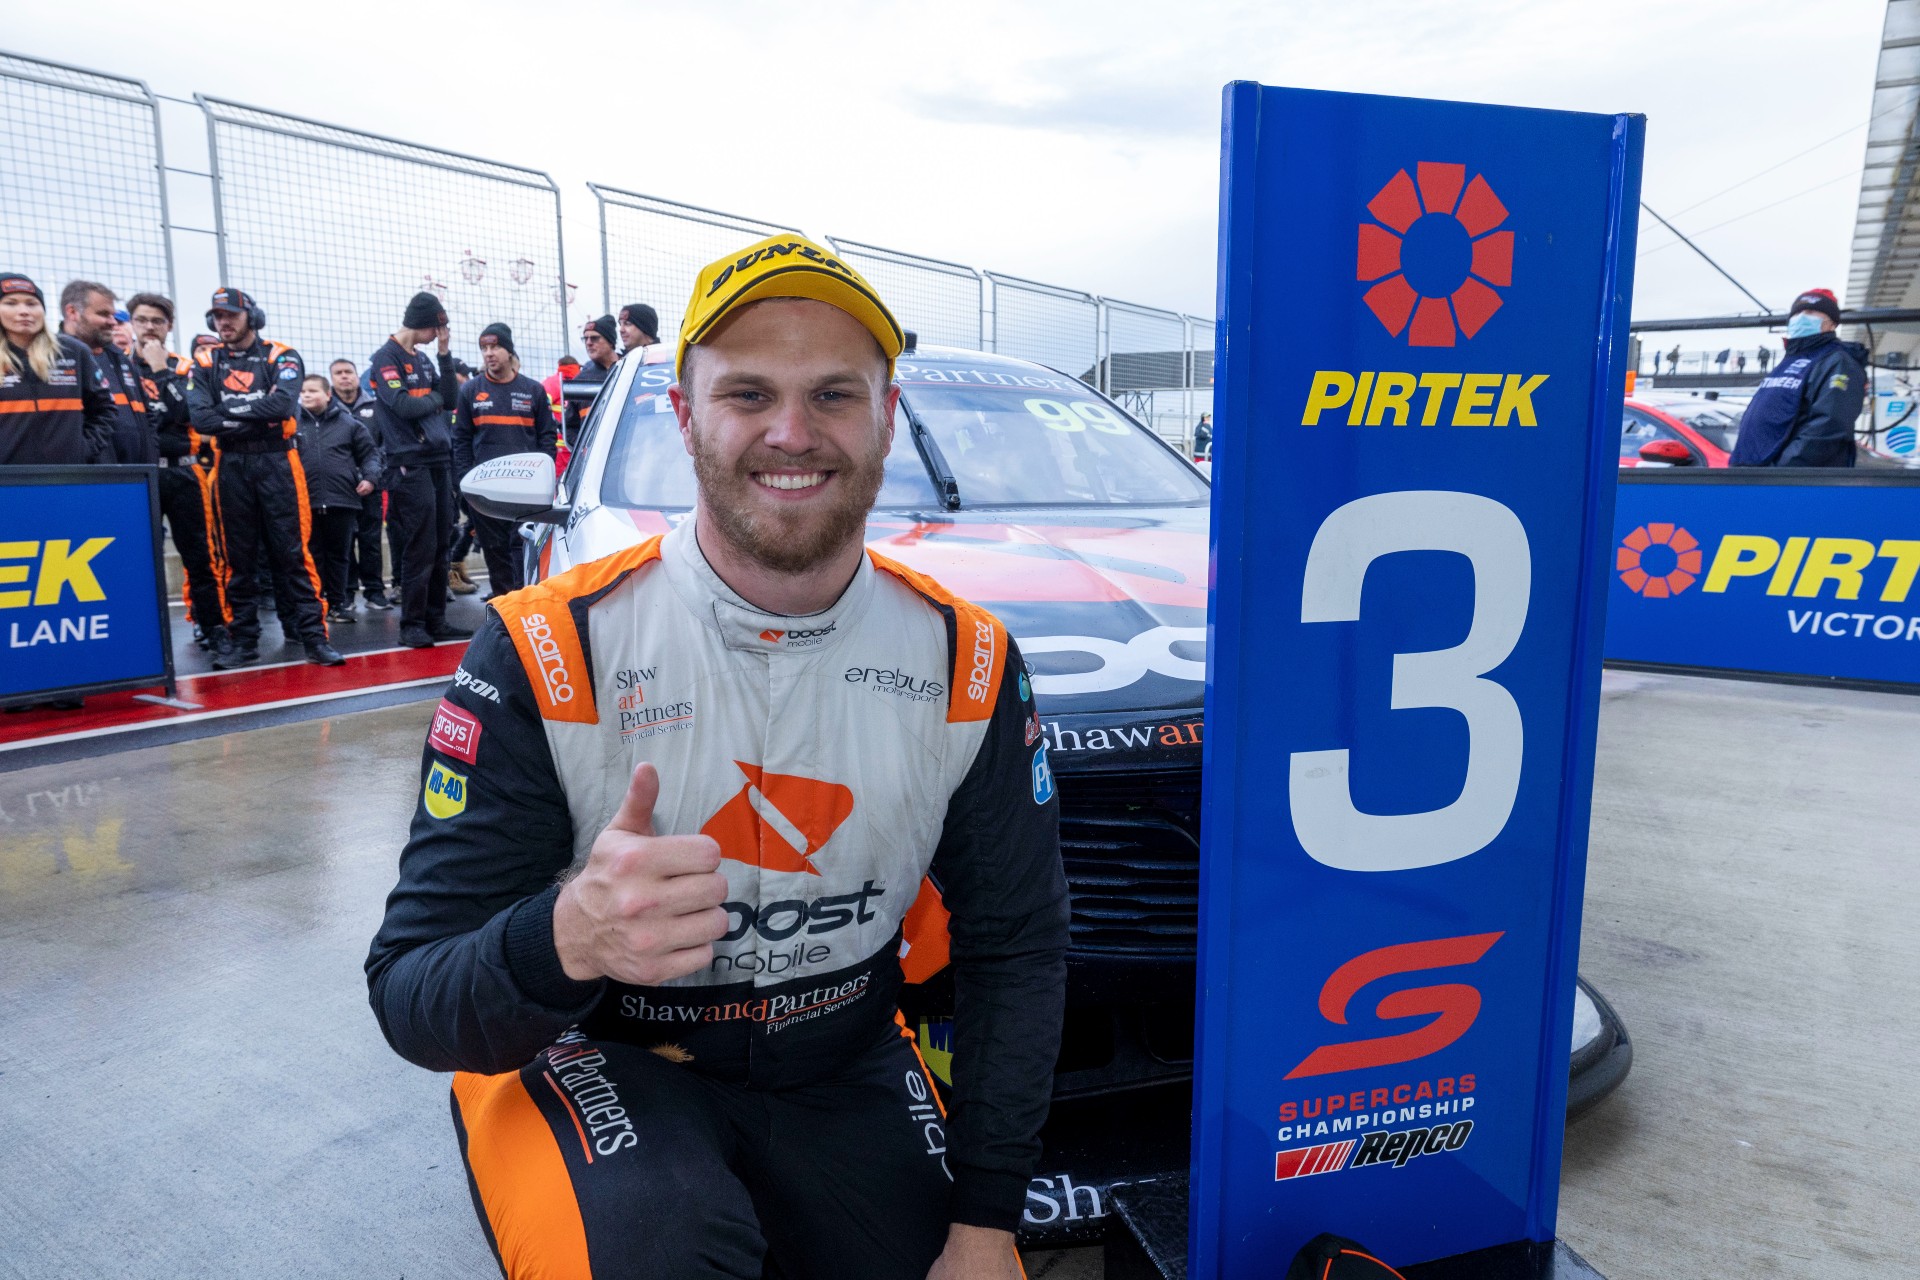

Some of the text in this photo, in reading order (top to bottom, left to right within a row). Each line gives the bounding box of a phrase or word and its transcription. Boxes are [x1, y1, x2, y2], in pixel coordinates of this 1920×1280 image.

[706, 242, 862, 298] DUNLO
[1023, 398, 1132, 436] 99
[1301, 371, 1551, 427] PIRTEK
[473, 468, 535, 480] Partners
[10, 614, 109, 648] LANE
[787, 638, 823, 647] mobile
[788, 621, 836, 639] boost
[523, 613, 574, 704] sparco
[967, 620, 992, 702] sparco
[845, 667, 943, 697] erebus
[1289, 490, 1532, 872] 3
[435, 714, 467, 742] grays
[657, 721, 694, 735] Services
[430, 768, 463, 802] WD-40
[766, 990, 867, 1035] Financial Services
[1278, 1097, 1475, 1141] CHAMPIONSHIP
[1279, 1074, 1476, 1122] SUPERCARS
[905, 1070, 953, 1182] bile
[1350, 1120, 1474, 1168] Repco
